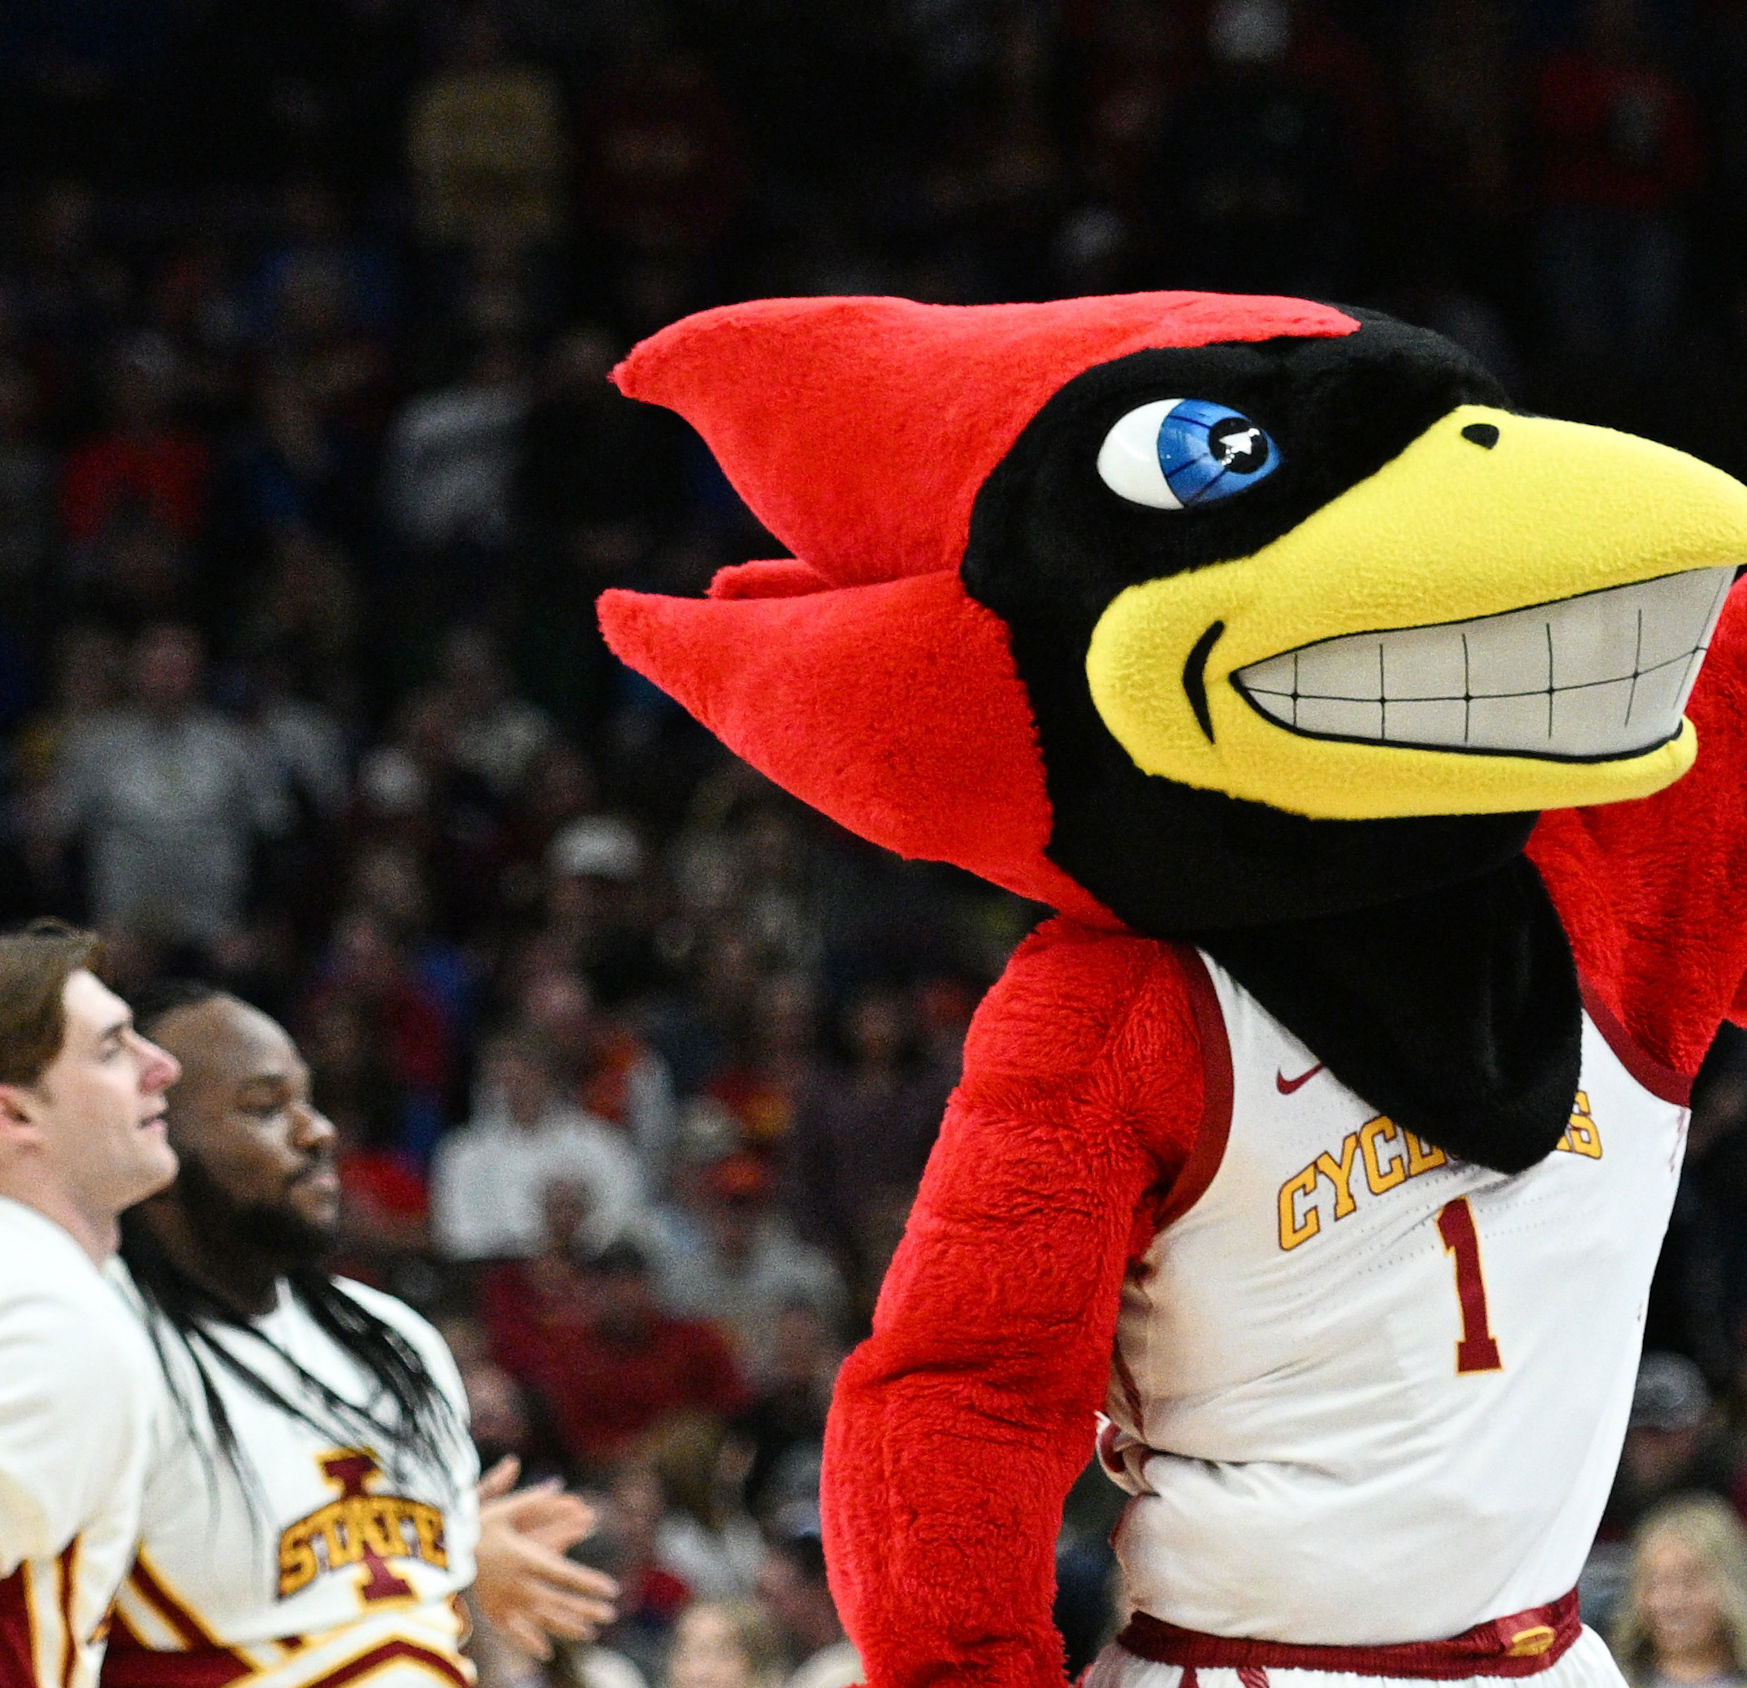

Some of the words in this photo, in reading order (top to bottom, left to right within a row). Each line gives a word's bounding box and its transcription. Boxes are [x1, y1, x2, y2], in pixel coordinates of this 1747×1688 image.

[1278, 1089, 1603, 1252] CYCLS
[1434, 1194, 1504, 1377] 1
[276, 1494, 449, 1606] STATE
